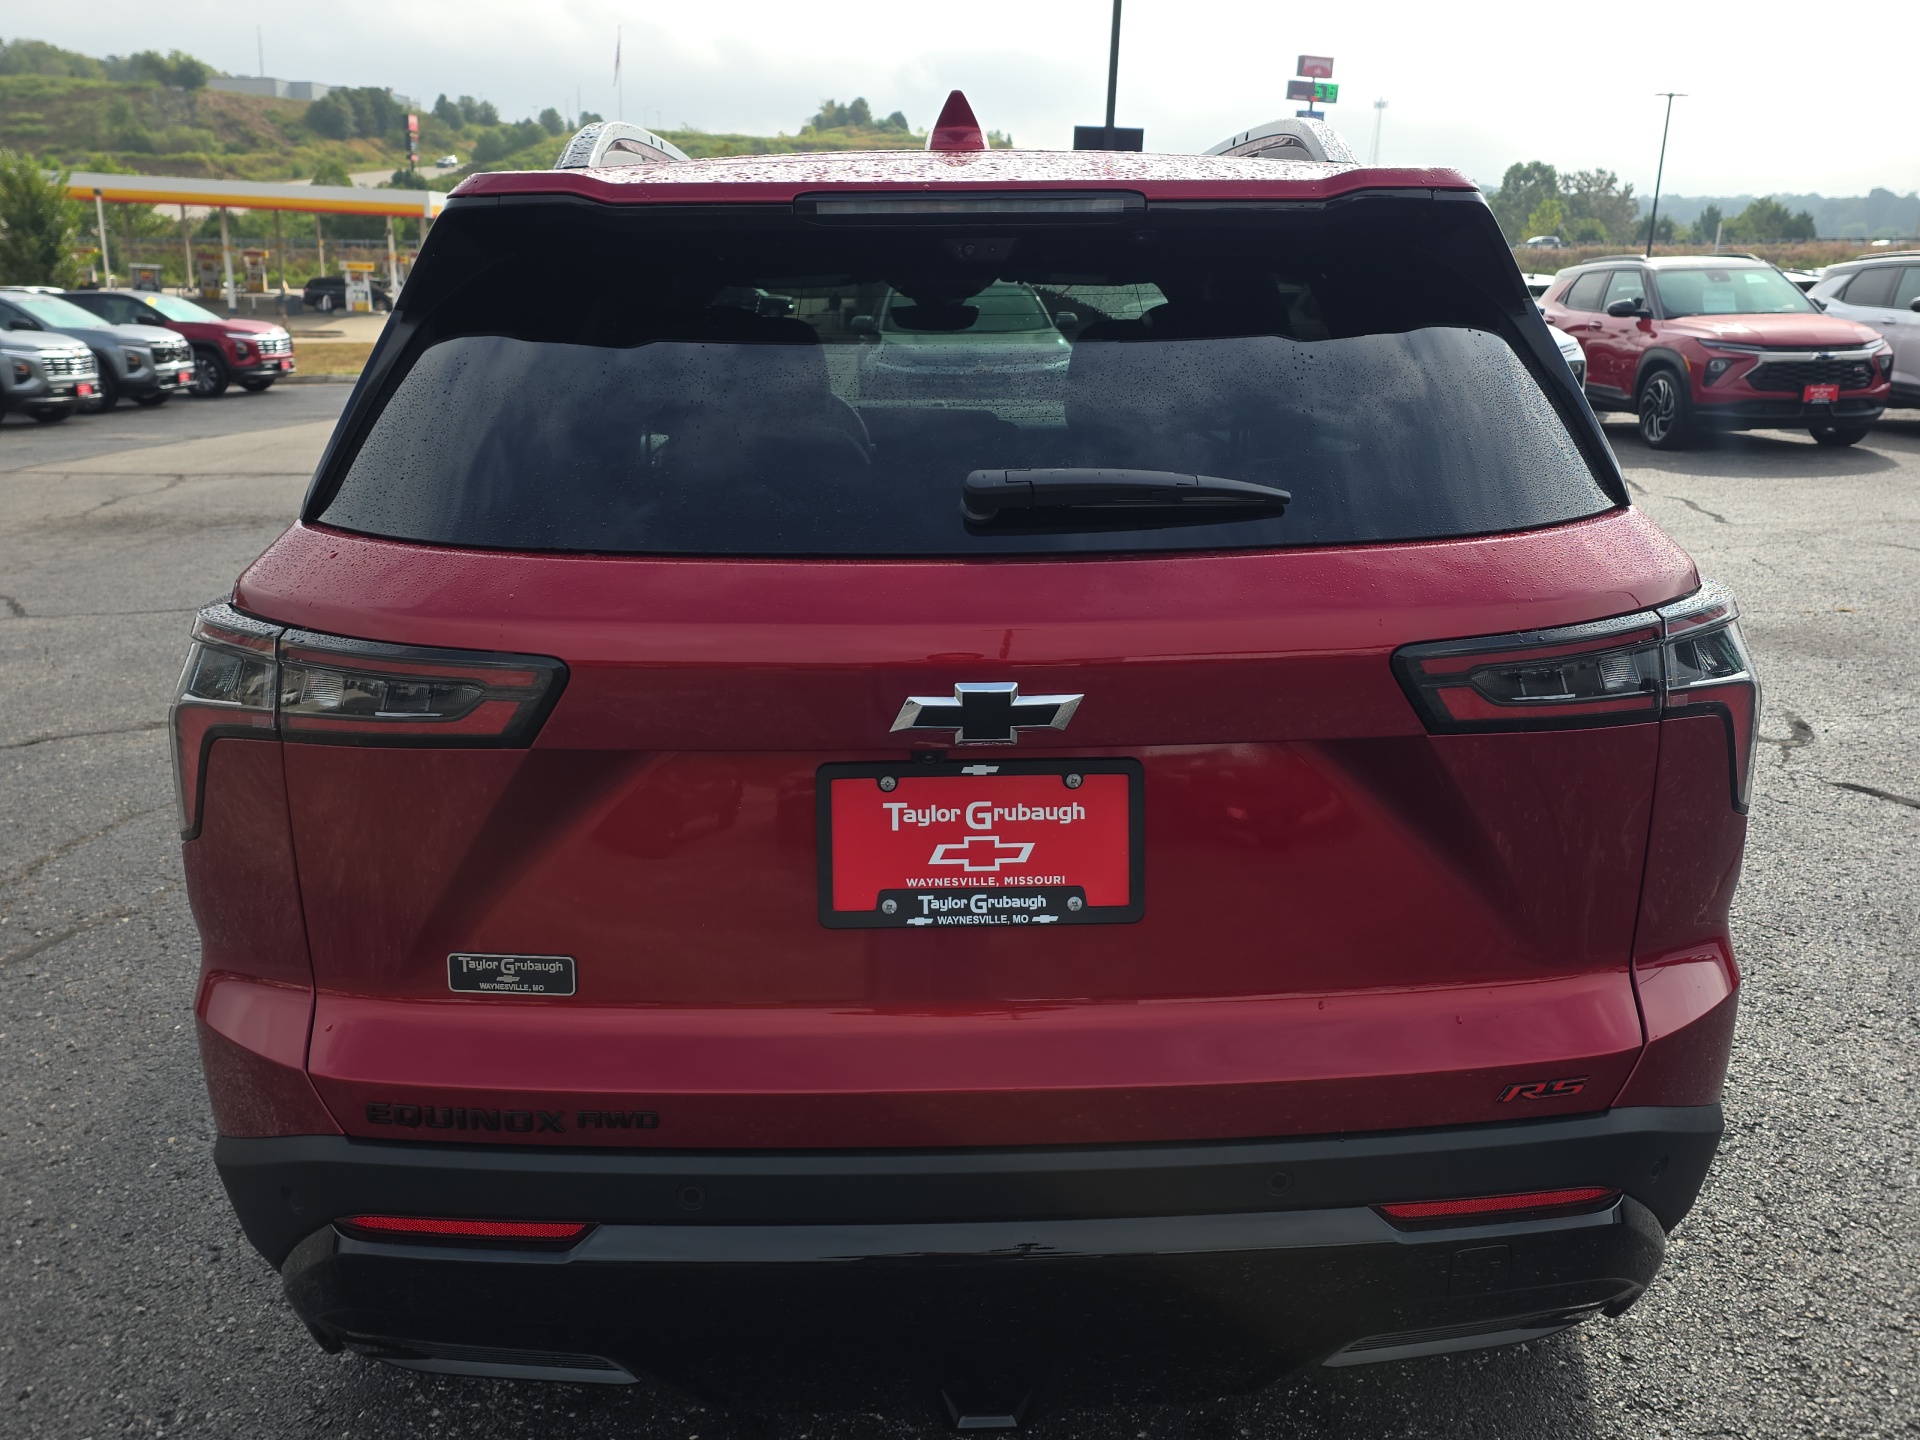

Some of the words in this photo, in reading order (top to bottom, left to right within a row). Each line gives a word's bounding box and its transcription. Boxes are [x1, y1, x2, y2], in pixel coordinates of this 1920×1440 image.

[883, 802, 960, 831] Taylor
[965, 801, 1085, 830] Grubaugh
[906, 876, 999, 888] WAYNESVILLE,
[1004, 875, 1066, 885] MISSOURI
[918, 895, 967, 914] Taylor
[970, 894, 1046, 913] Grubaugh
[937, 915, 1010, 925] WAYNESVILLE,
[1012, 914, 1029, 924] MO
[458, 957, 498, 973] Taylor
[500, 958, 563, 974] Grubaugh
[479, 982, 531, 992] WAYNESVILLE,
[532, 984, 545, 992] MO
[1496, 1076, 1590, 1103] RS
[365, 1102, 566, 1134] EQUINOX
[576, 1111, 660, 1129] AWD
